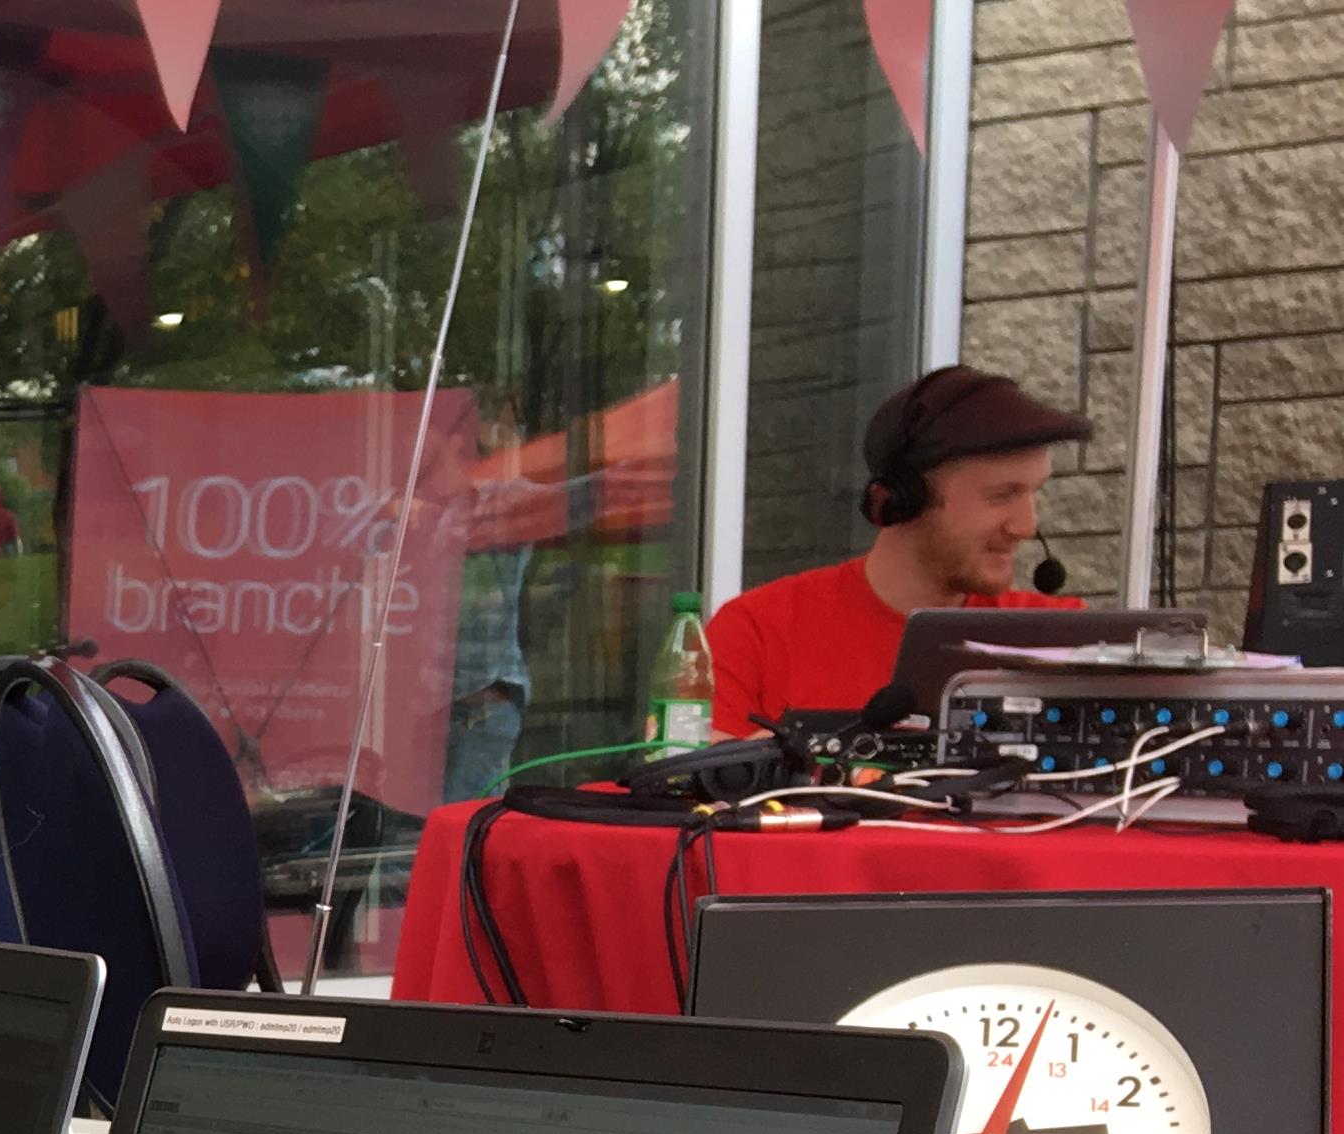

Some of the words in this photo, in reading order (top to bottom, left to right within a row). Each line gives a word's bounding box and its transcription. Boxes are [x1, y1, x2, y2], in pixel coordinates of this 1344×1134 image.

[132, 473, 403, 560] 100%
[104, 562, 421, 636] branché
[166, 1014, 183, 1026] Auto
[183, 1015, 204, 1028] Logon
[204, 1017, 219, 1028] with
[979, 1016, 1021, 1050] 12
[986, 1051, 1015, 1068] 24
[1067, 1032, 1079, 1063] 1
[1047, 1061, 1068, 1079] 13
[1090, 1097, 1111, 1114] 14
[1116, 1075, 1142, 1109] 2
